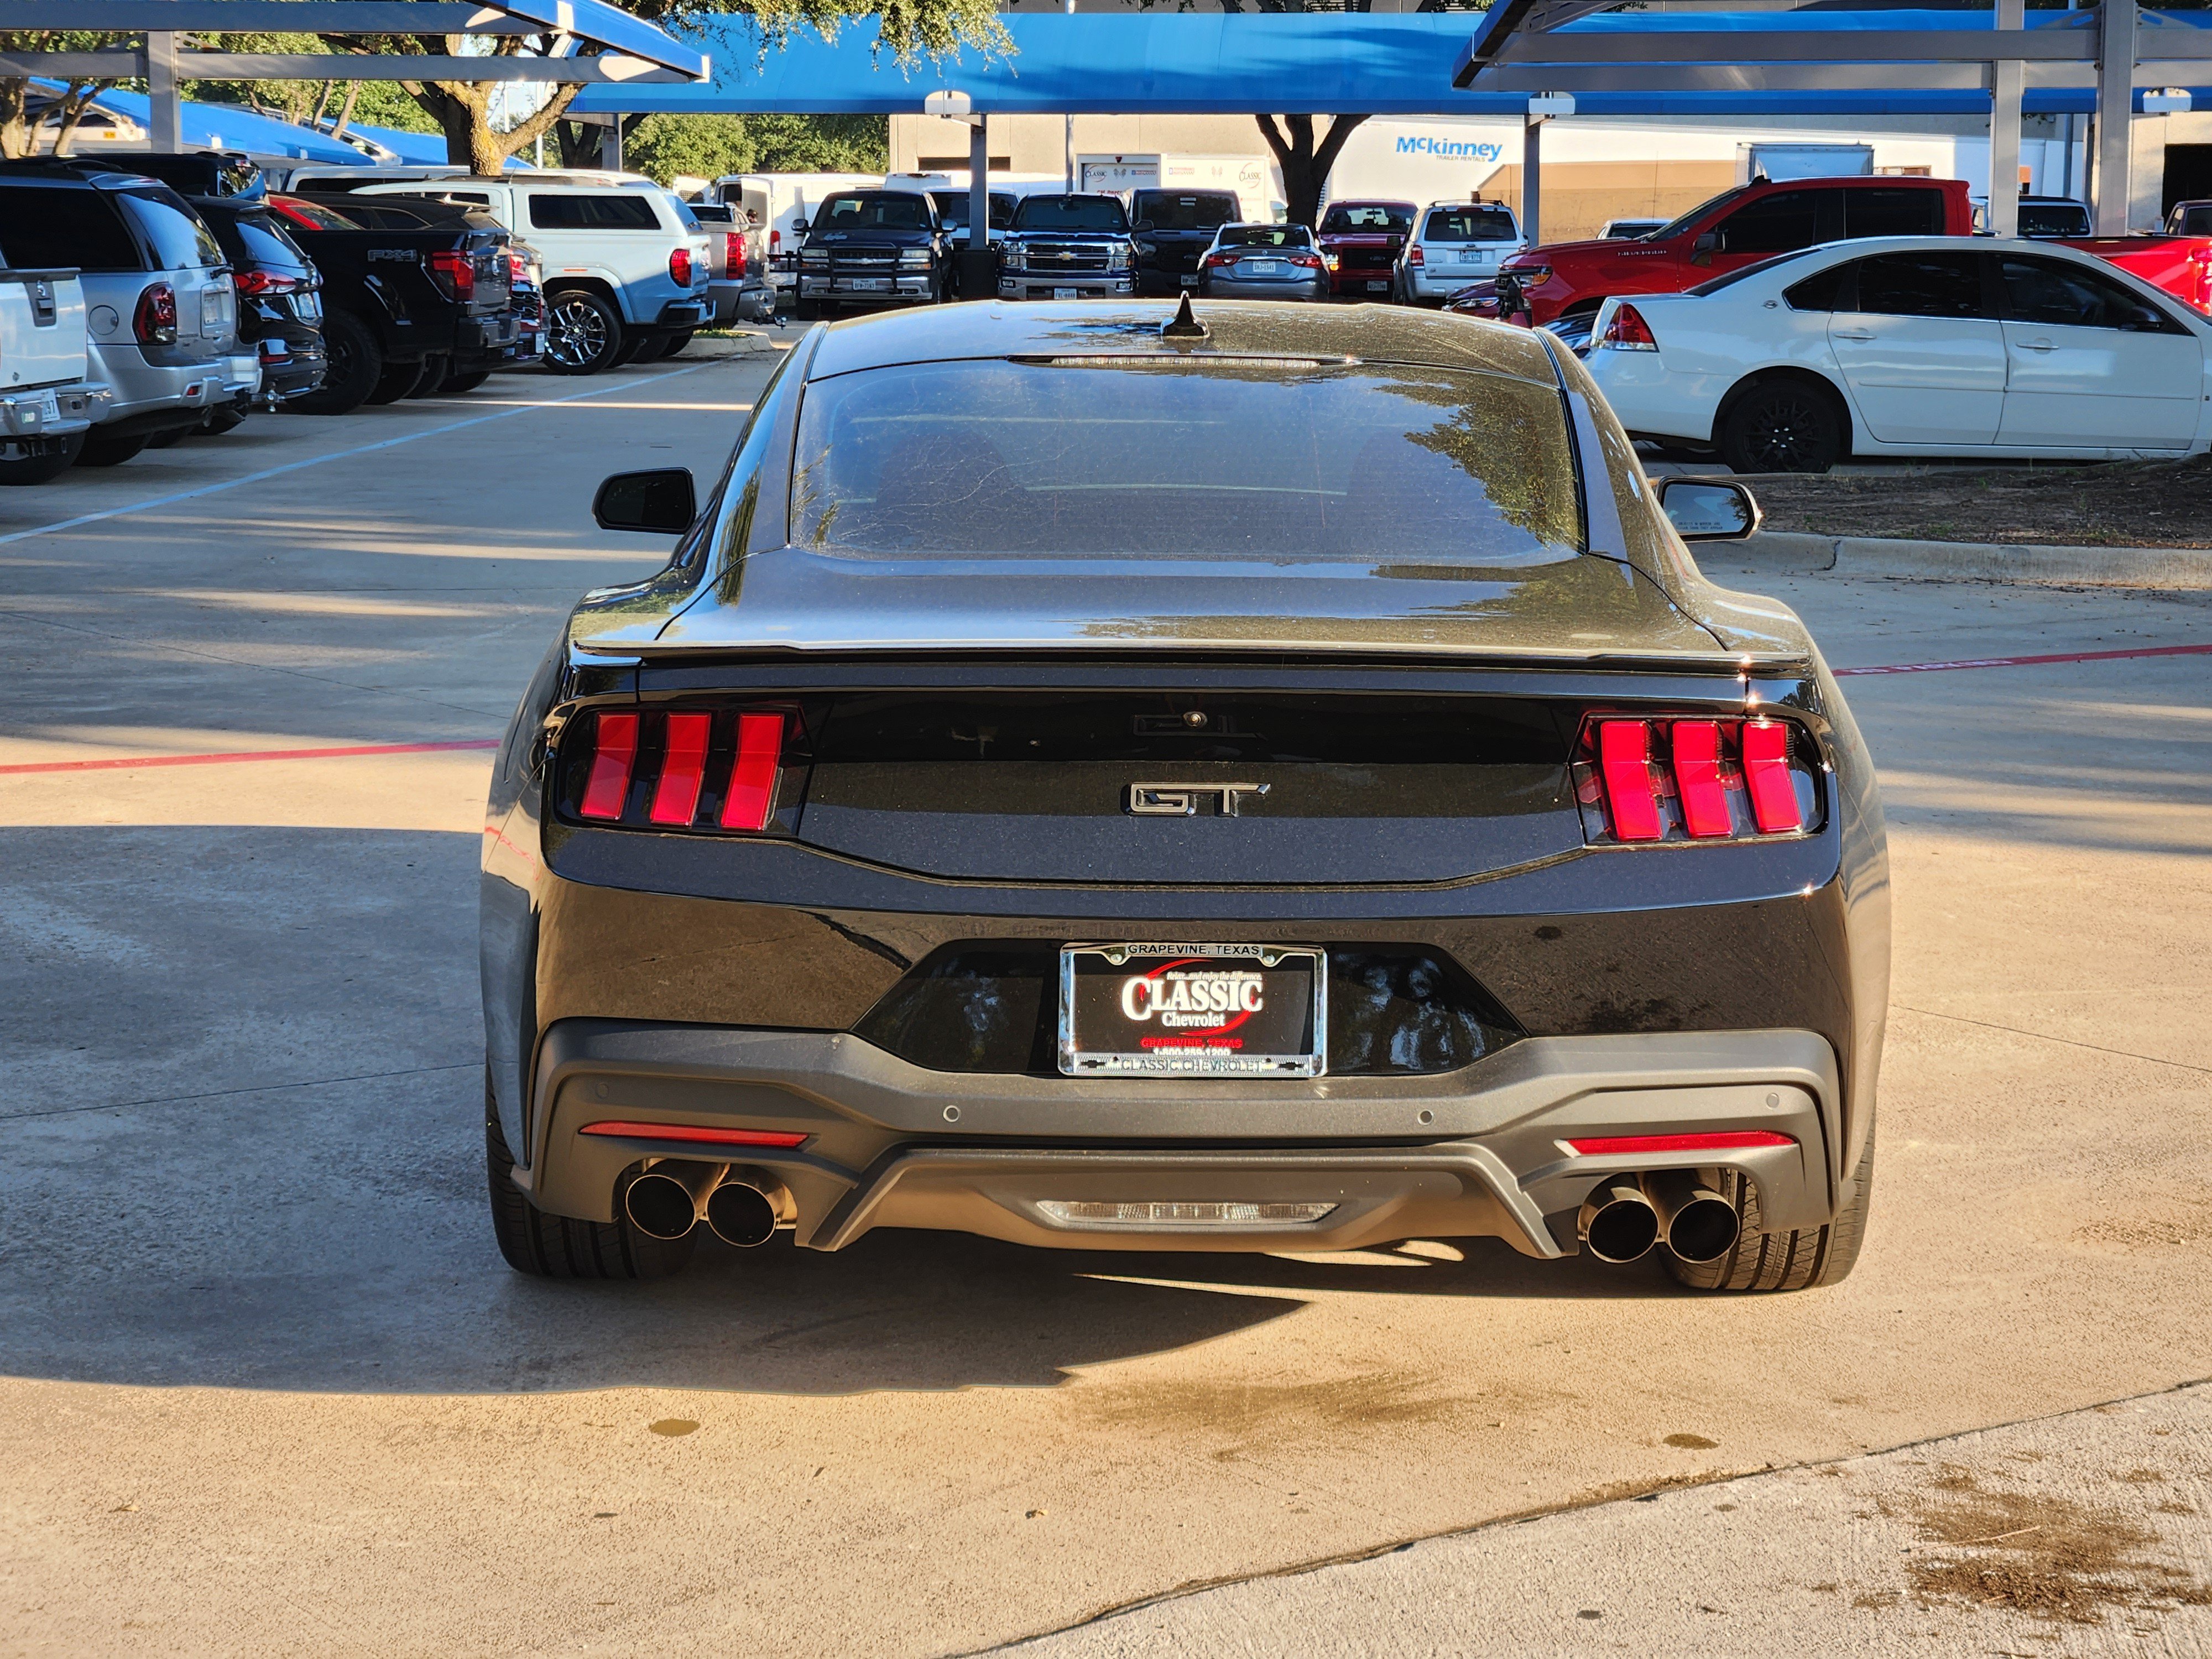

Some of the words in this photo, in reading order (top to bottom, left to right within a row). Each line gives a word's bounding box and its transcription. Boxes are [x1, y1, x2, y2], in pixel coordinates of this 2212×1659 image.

[367, 249, 418, 262] FX4
[1122, 782, 1271, 817] GT
[1128, 945, 1211, 955] GRAPEVINE,
[1217, 945, 1259, 956] TEXAS
[1219, 971, 1230, 980] the
[1122, 977, 1264, 1021] CLASSIC
[1162, 1011, 1225, 1027] Chevrolet
[1140, 1037, 1205, 1048] GRAPEVINE,
[1207, 1037, 1243, 1048] TEXAS
[1121, 1059, 1178, 1071] CLASSIC
[1183, 1059, 1262, 1072] CHEVROLET
